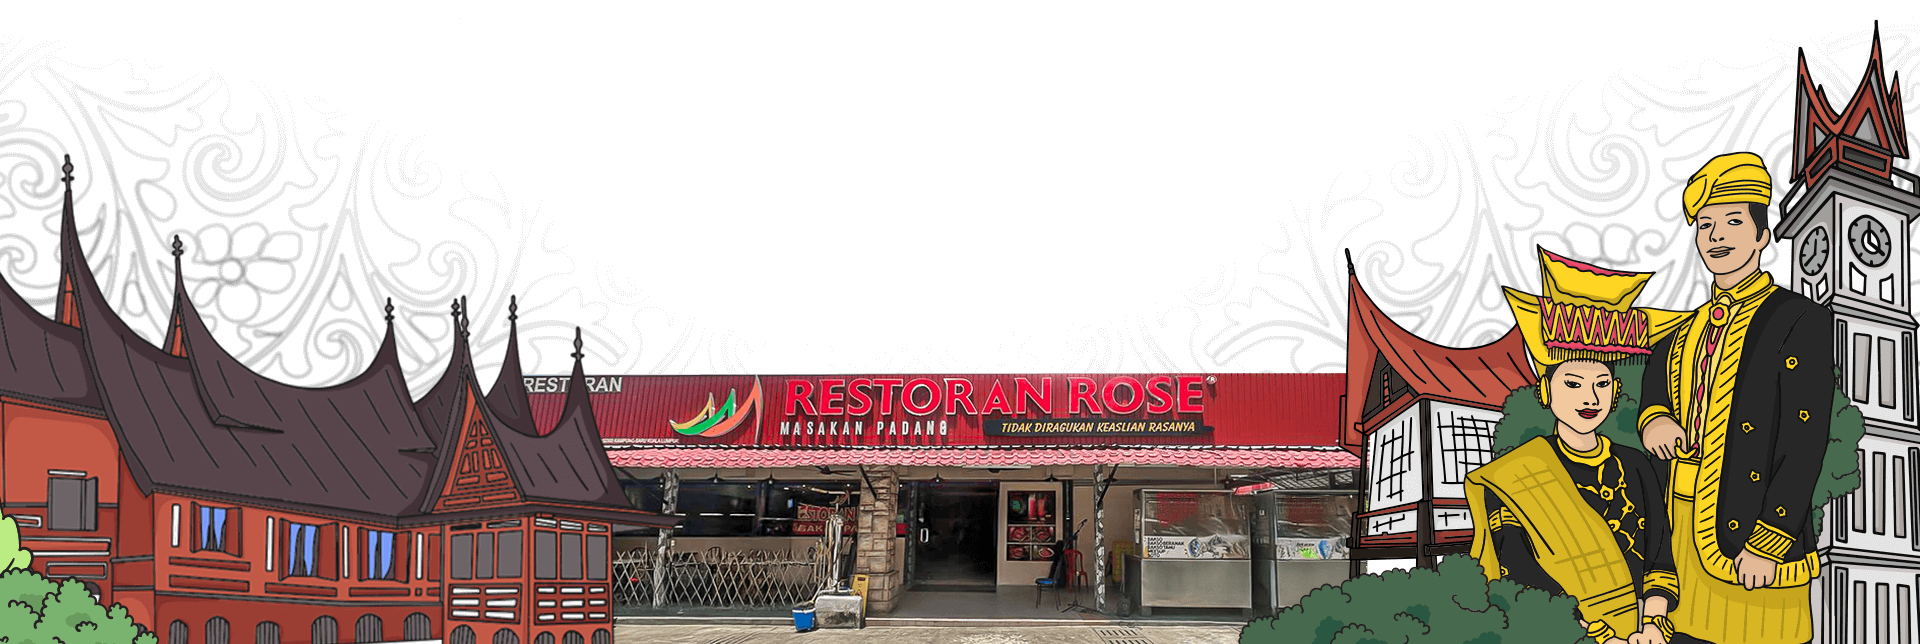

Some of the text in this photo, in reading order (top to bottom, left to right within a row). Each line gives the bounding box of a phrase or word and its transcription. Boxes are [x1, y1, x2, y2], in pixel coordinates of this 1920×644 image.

[523, 377, 622, 392] RESTRAN
[785, 377, 1051, 415] RESTORAN
[1067, 376, 1204, 414] ROSE
[780, 420, 948, 436] MASAKAN PADANG
[1001, 421, 1196, 433] TIDAK DIRAGUKAN KEASLIAN RASANYA
